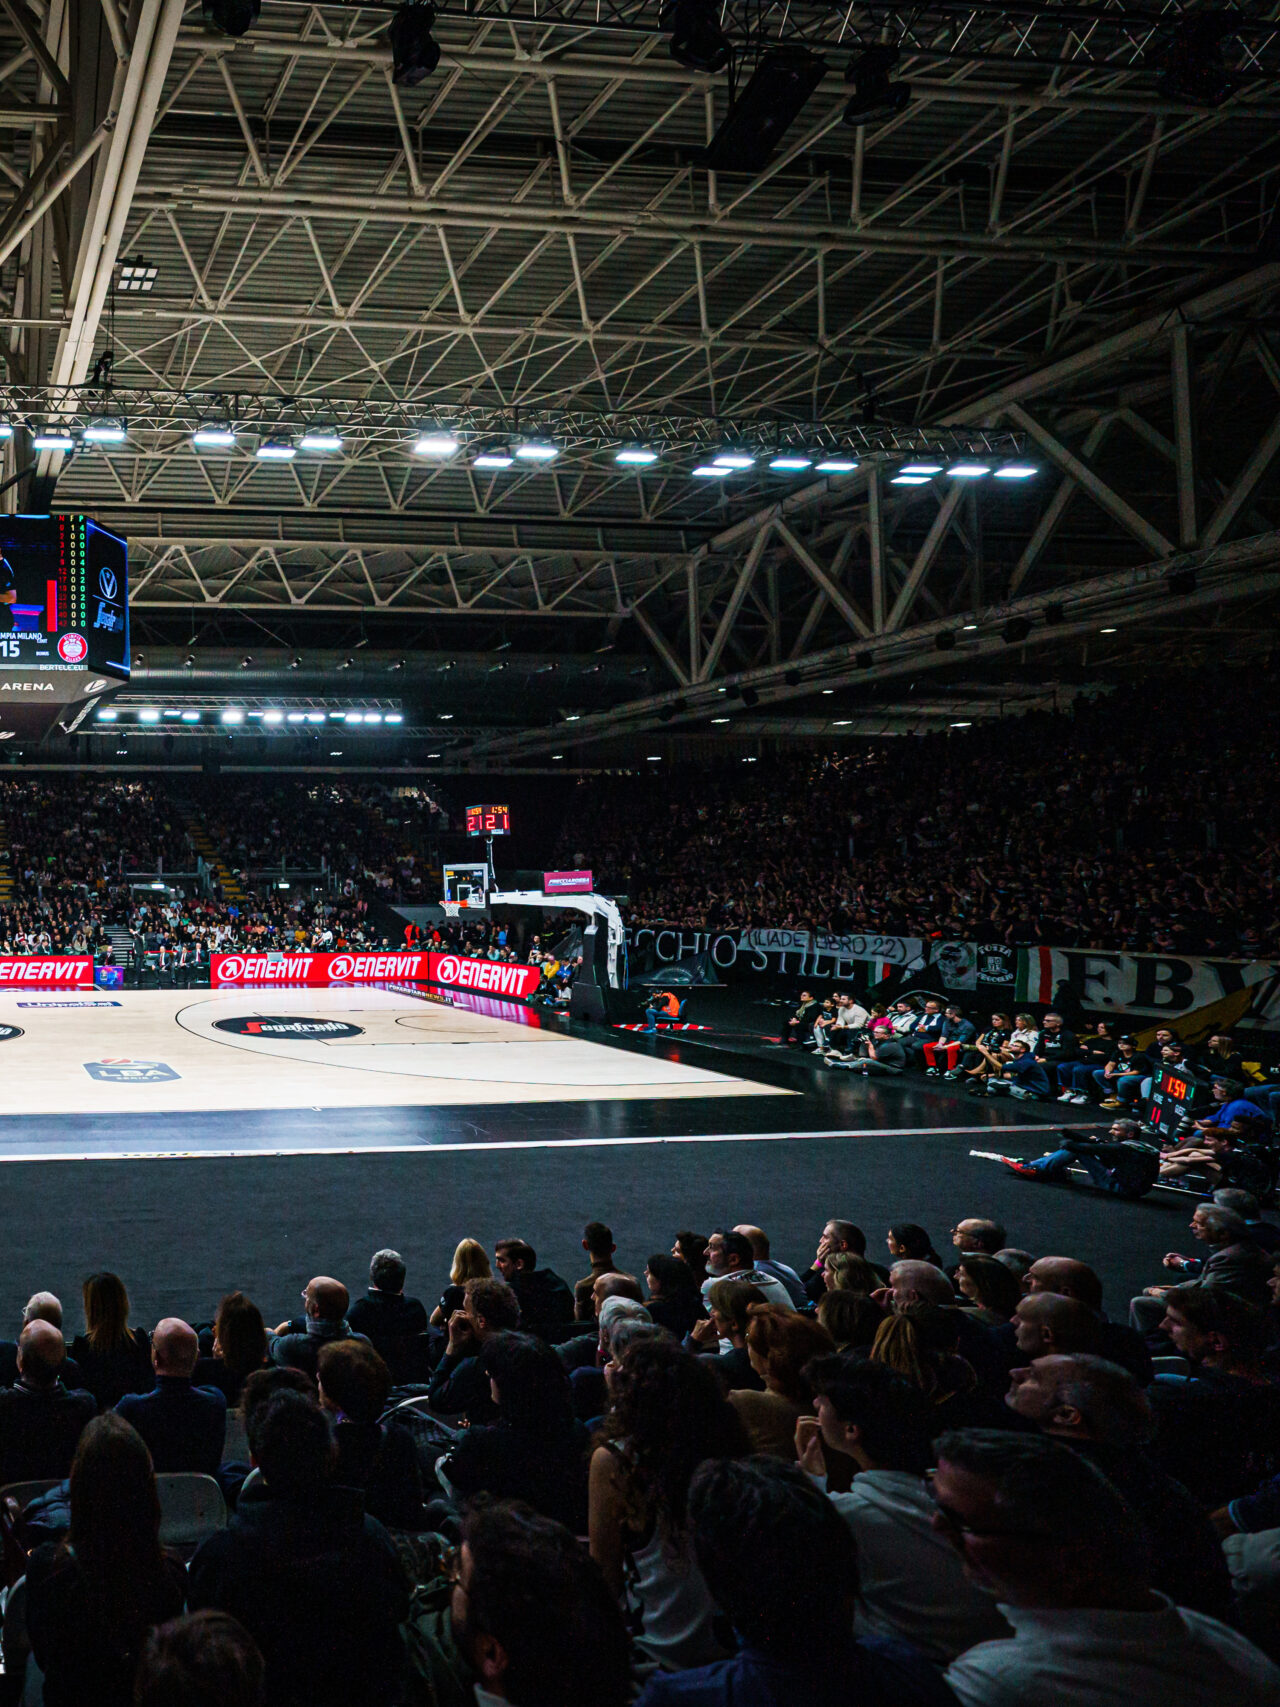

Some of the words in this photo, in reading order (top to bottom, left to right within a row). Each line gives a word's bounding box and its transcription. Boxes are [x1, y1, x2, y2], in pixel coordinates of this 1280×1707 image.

[0, 641, 20, 657] 15
[1, 683, 54, 691] ARENA
[491, 806, 508, 814] 1:54
[467, 815, 482, 831] 21
[485, 814, 509, 830] 21
[622, 927, 738, 968] ECCHIO
[243, 958, 314, 978] ENERVIT
[353, 956, 422, 977] ENERVIT
[459, 960, 529, 995] ENERVIT
[240, 1021, 349, 1034] Segafredo
[1167, 1077, 1187, 1100] 1:54
[1151, 1106, 1161, 1124] 11
